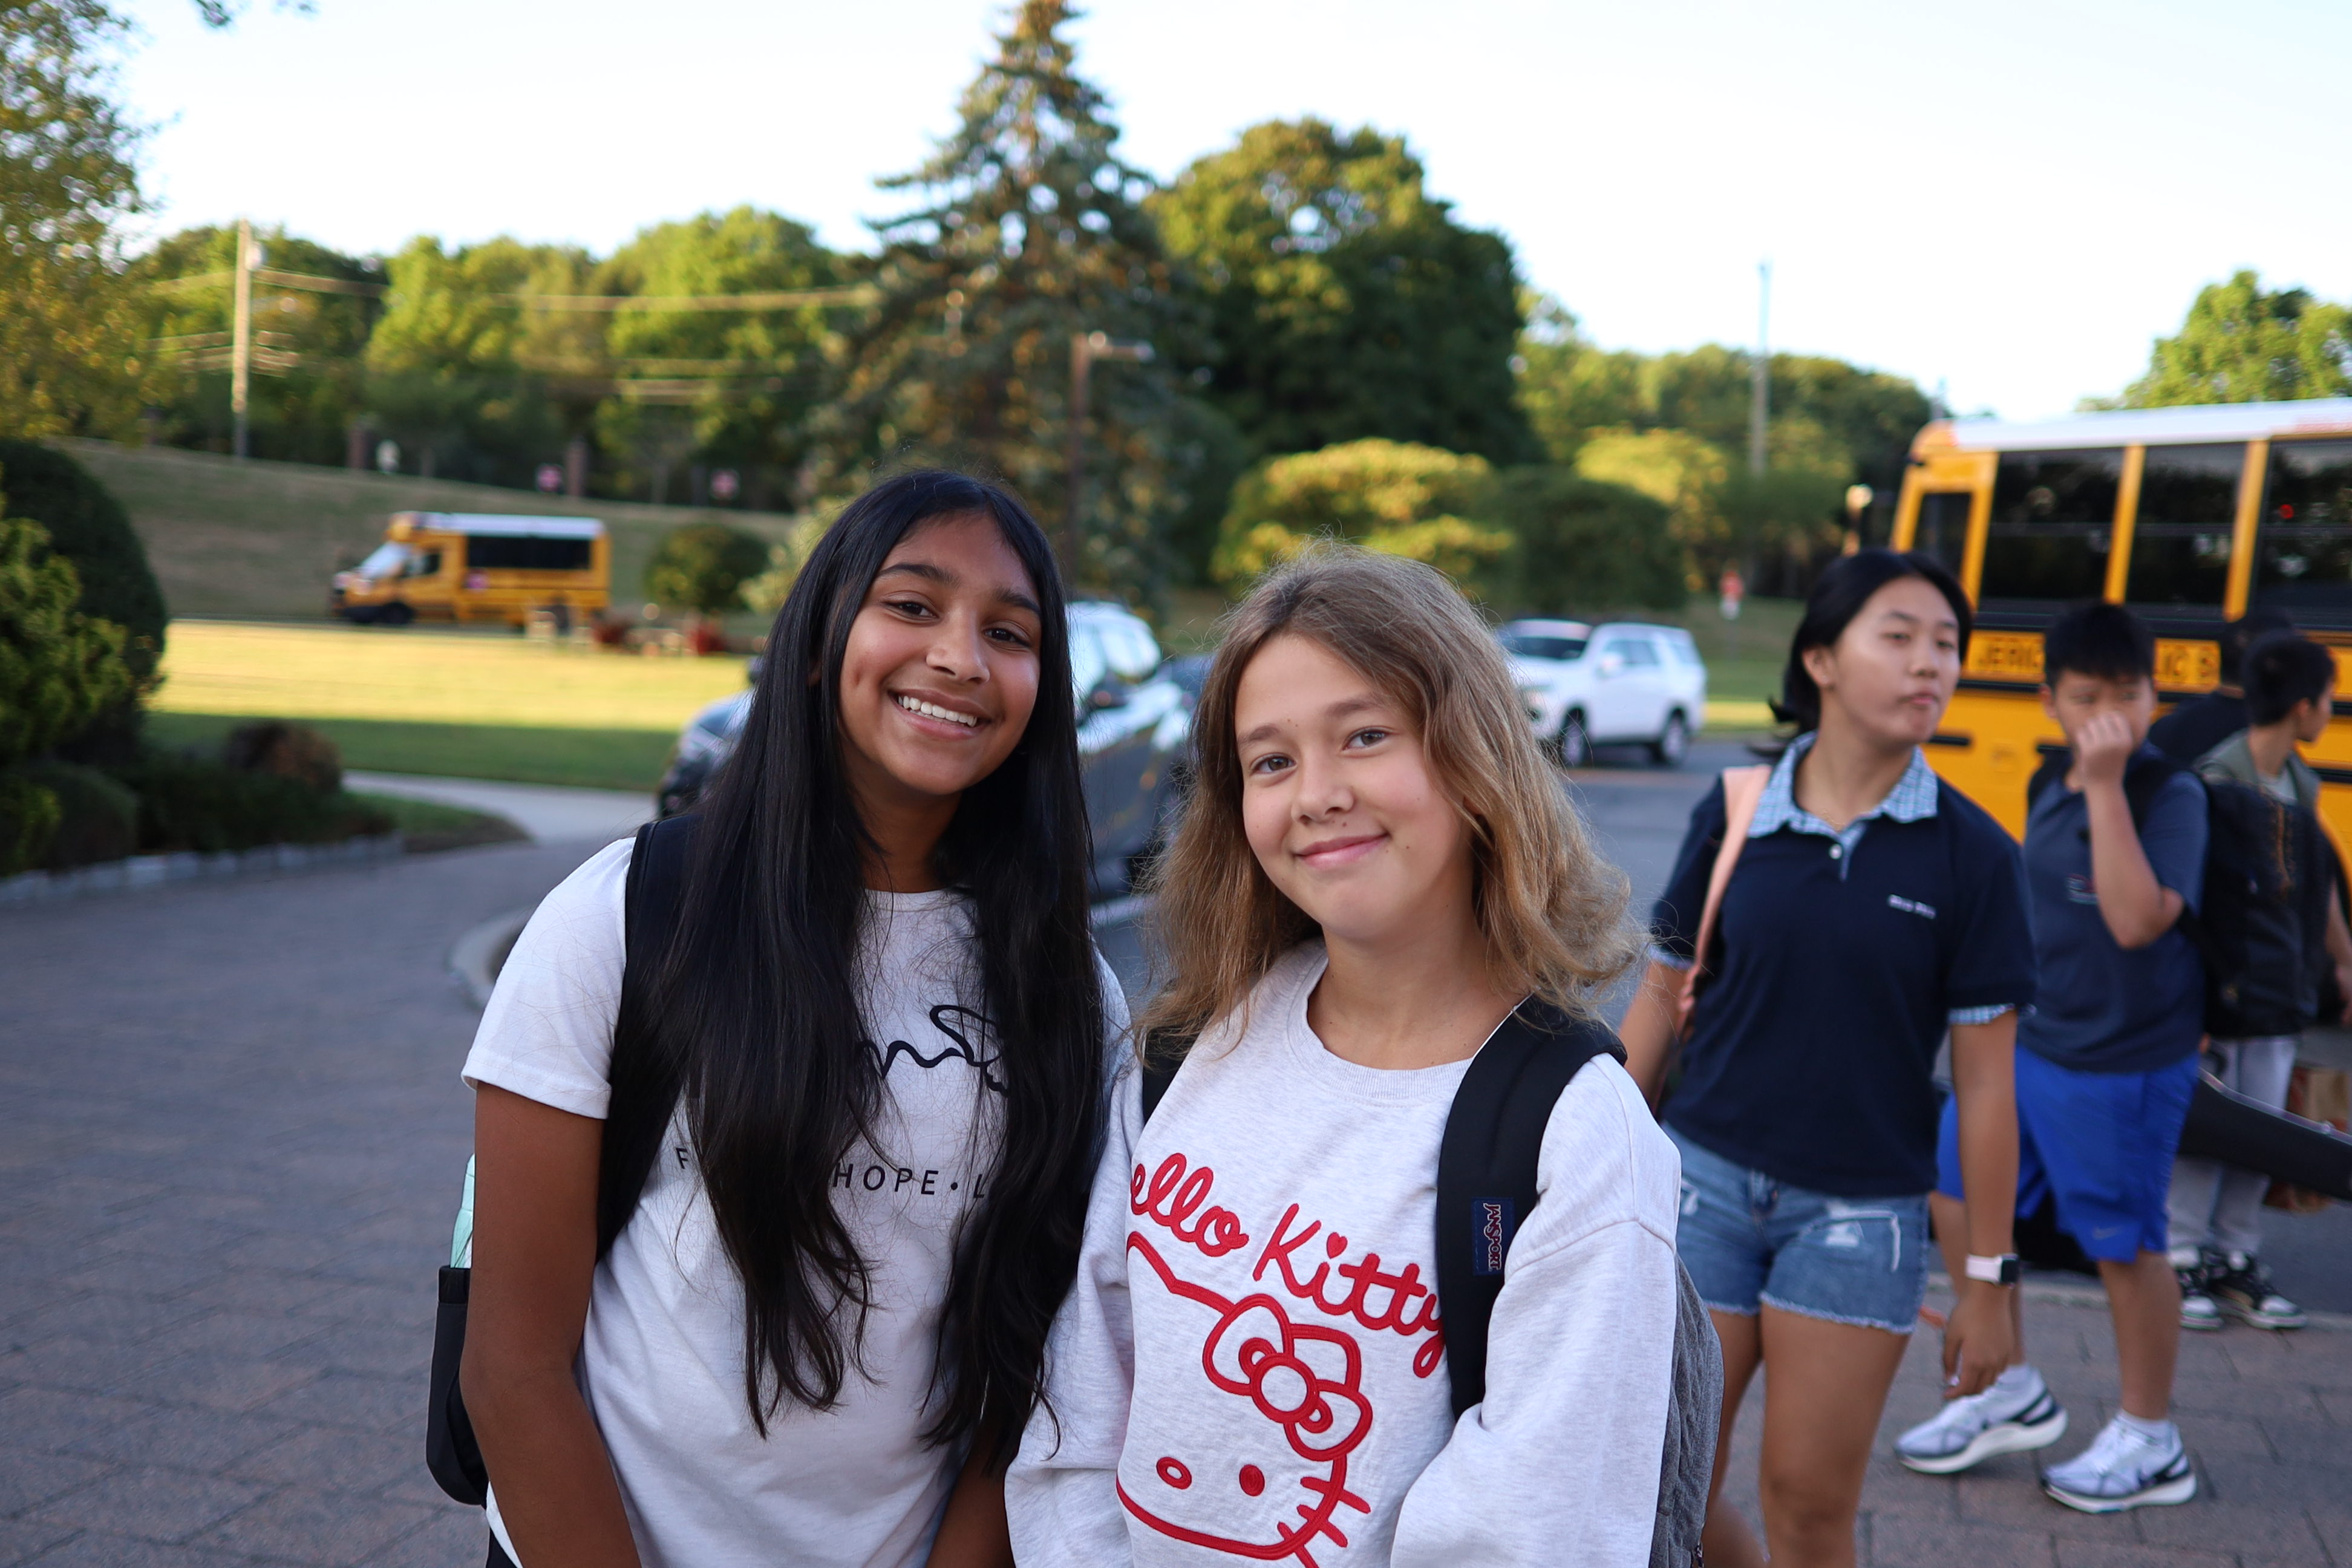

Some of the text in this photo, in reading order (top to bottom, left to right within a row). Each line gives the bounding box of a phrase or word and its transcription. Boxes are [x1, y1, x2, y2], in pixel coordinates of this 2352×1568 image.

[832, 1163, 939, 1195] HOPE
[1131, 1152, 1446, 1378] ello Kitty
[1483, 1203, 1502, 1270] JANSPORT
